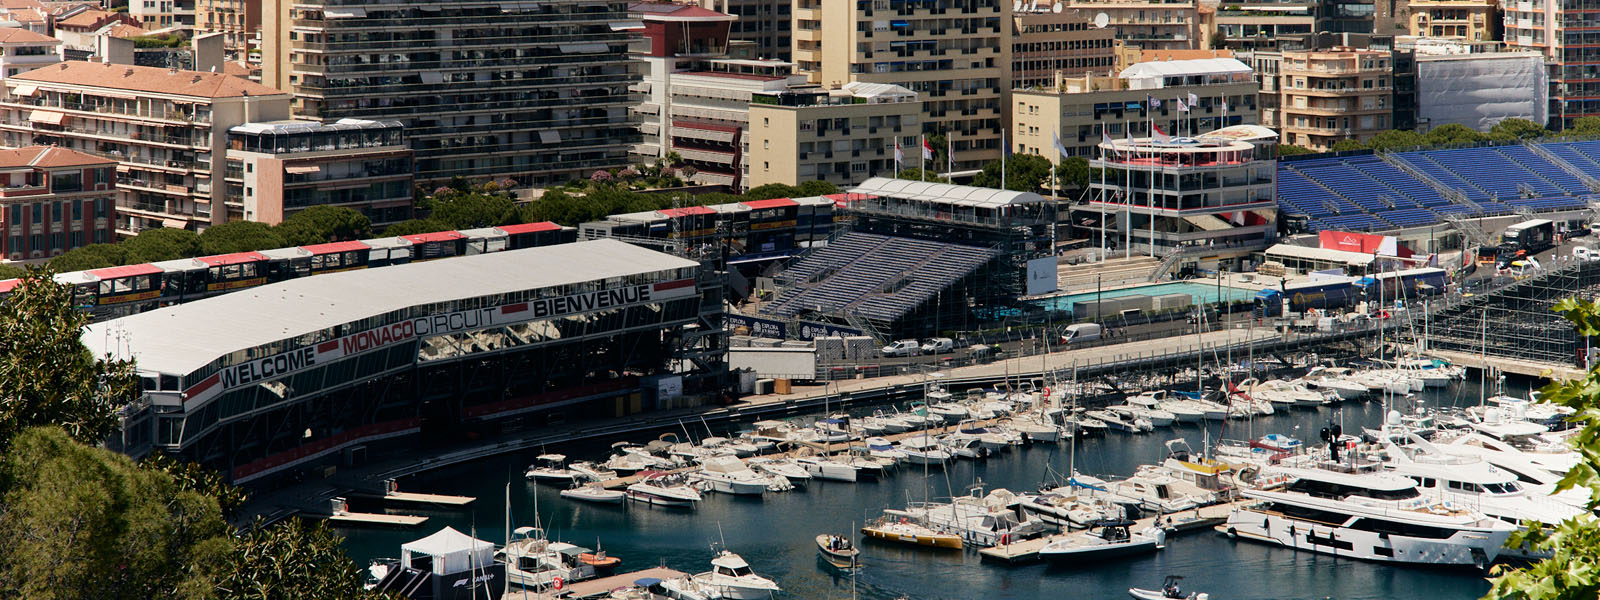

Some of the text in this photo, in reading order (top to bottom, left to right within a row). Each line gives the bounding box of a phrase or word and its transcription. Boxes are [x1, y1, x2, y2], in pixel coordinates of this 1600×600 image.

[220, 285, 650, 390] WELCOME MONACO CIRCUIT BIENVENUE
[761, 322, 779, 330] EXPLORA
